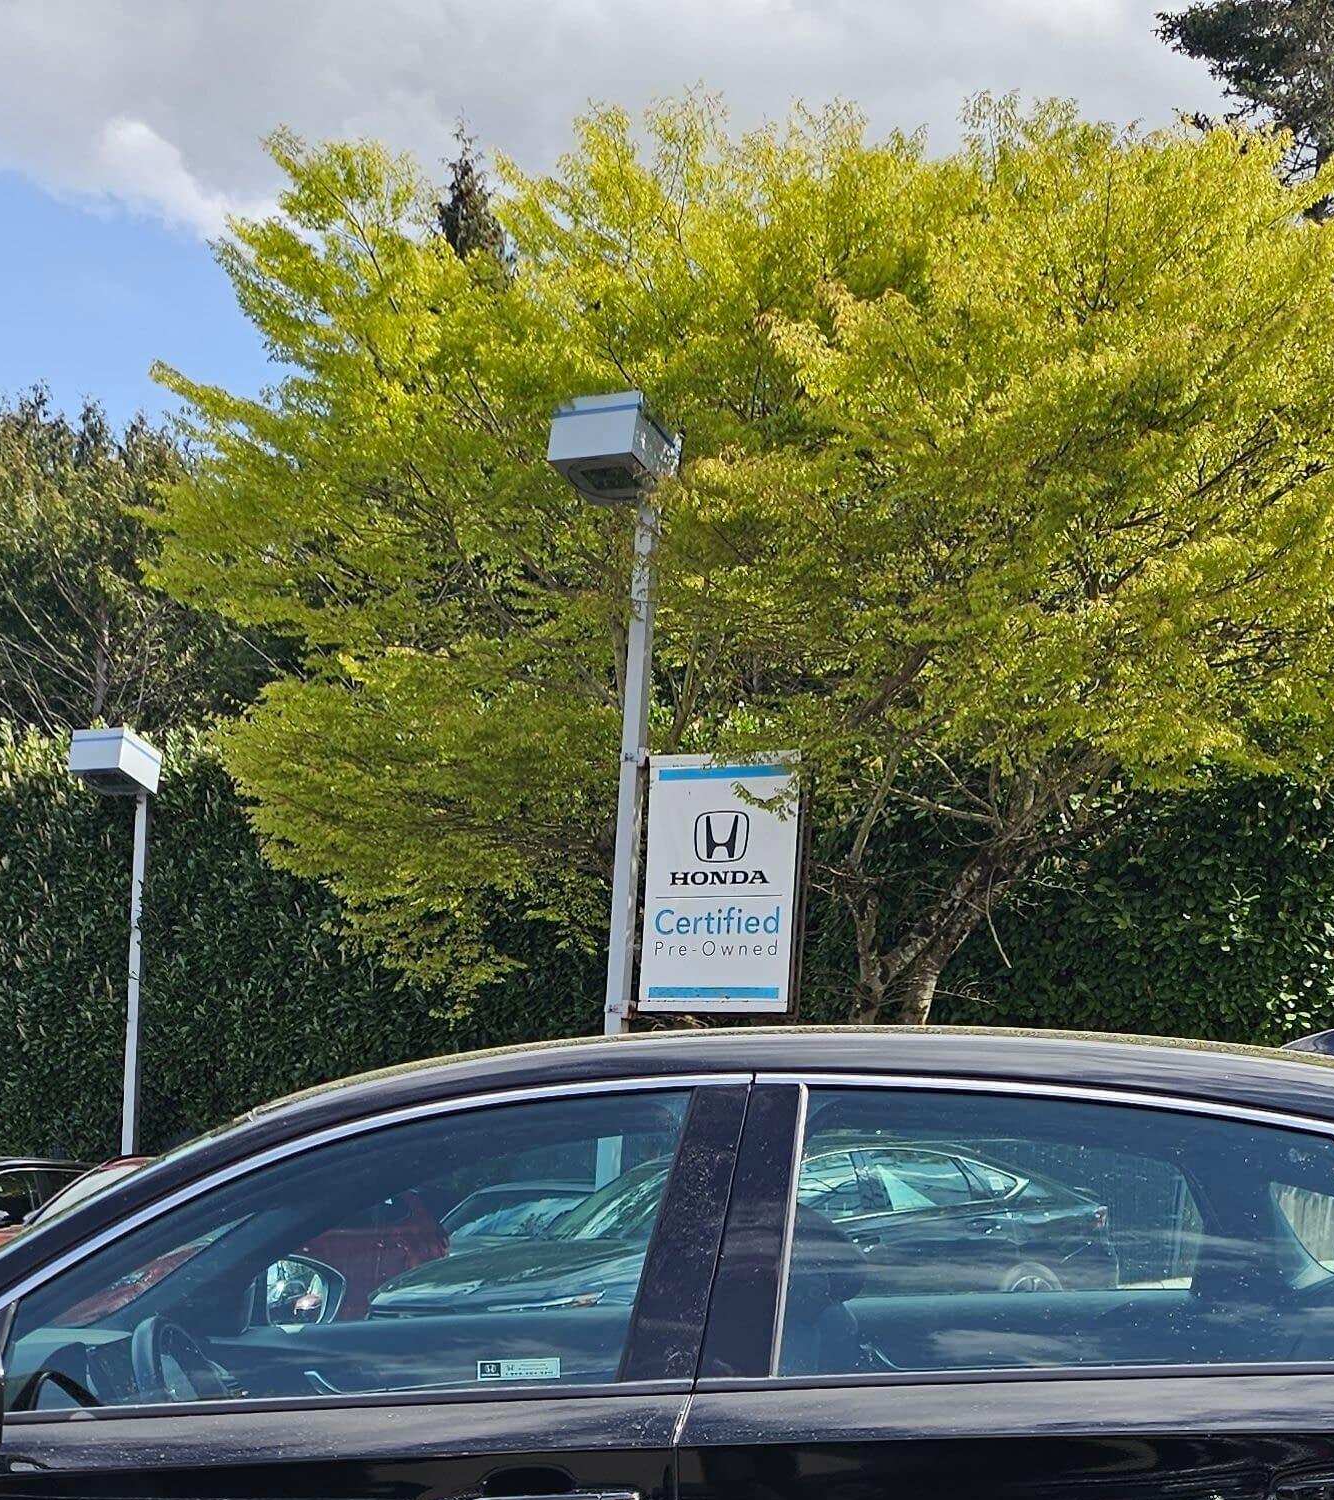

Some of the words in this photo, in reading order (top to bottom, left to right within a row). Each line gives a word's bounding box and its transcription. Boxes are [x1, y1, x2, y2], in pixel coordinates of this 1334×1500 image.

[669, 871, 770, 886] HONDA
[655, 906, 780, 935] Certified
[654, 940, 778, 956] Pre-Owned
